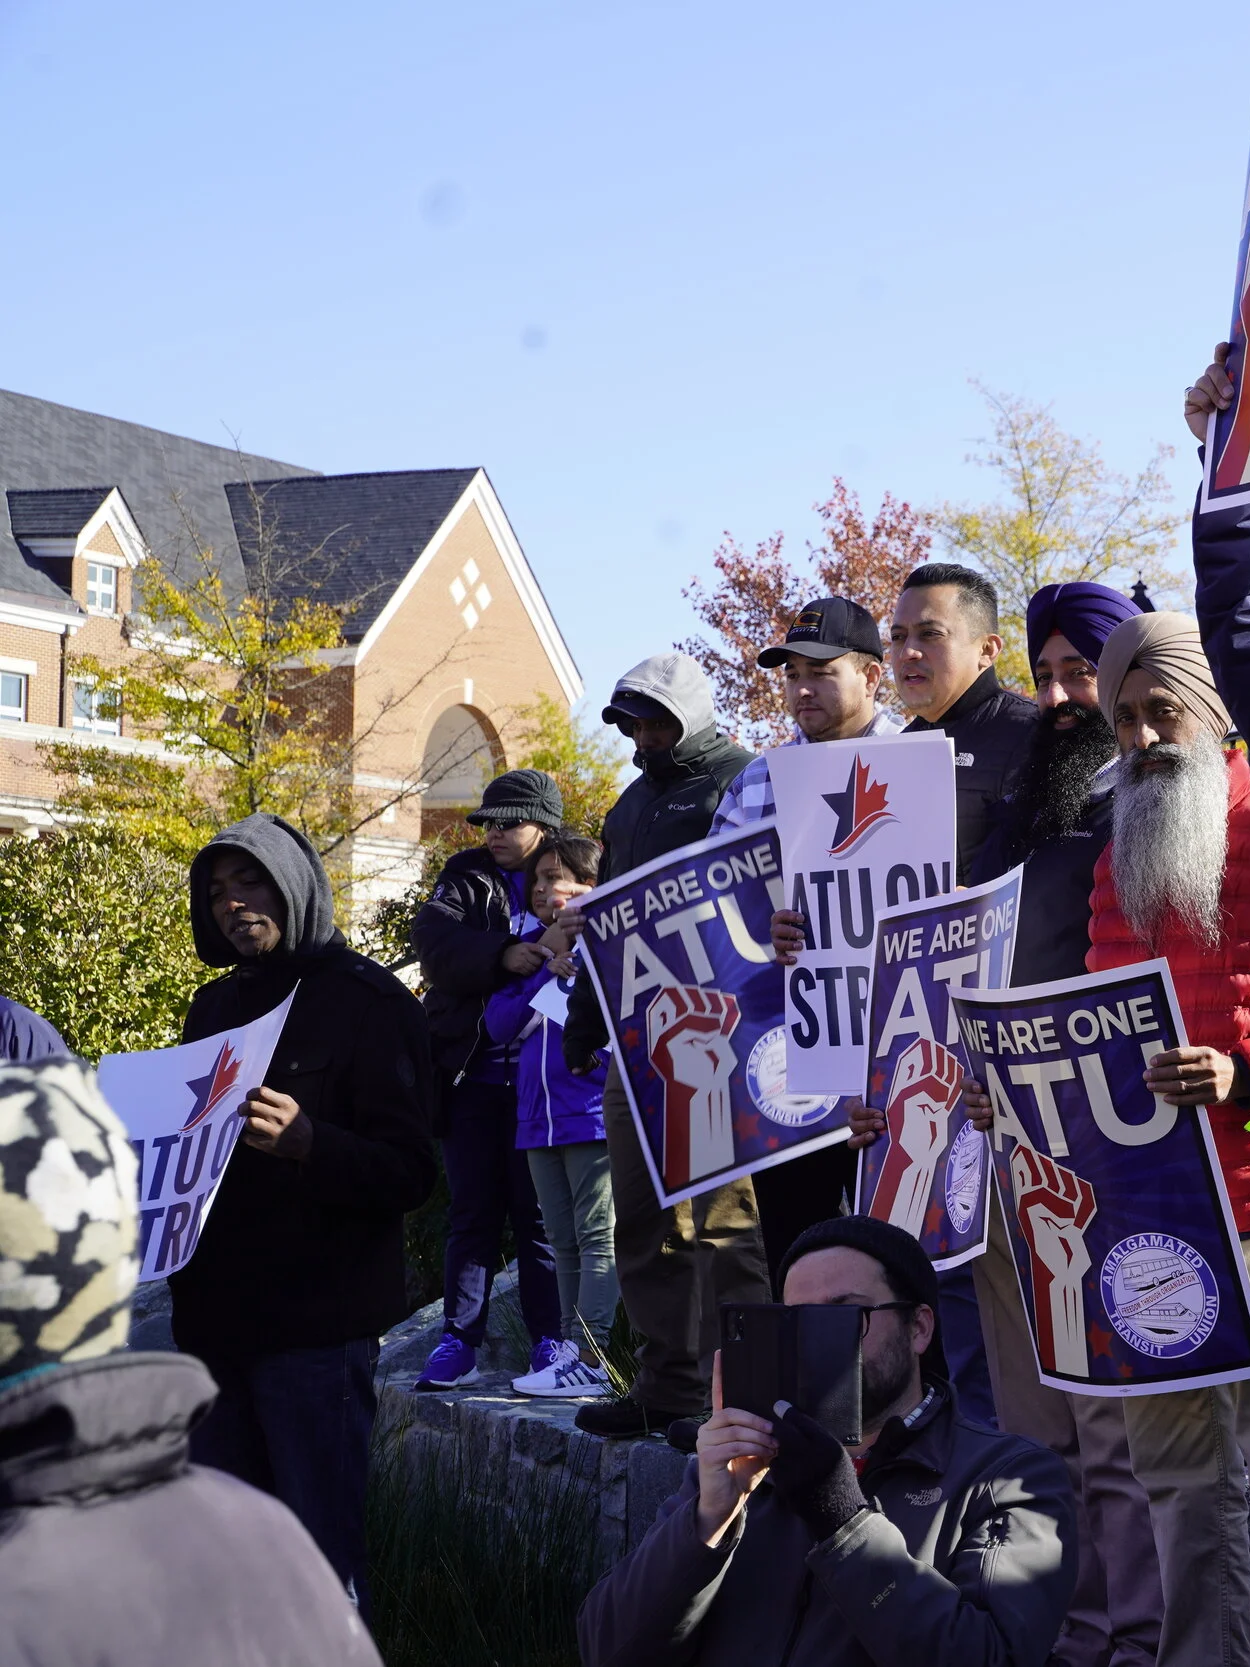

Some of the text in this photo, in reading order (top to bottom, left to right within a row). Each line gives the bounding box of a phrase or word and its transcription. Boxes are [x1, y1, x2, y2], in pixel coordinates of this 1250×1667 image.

[588, 842, 778, 942] WE ARE ONE
[791, 868, 875, 951] ATU
[620, 875, 785, 1021] ATU
[883, 897, 1014, 964] WE ARE ONE
[960, 995, 1159, 1055] WE ARE ONE
[985, 1039, 1179, 1158] ATU
[1102, 1235, 1203, 1287] AMALGAMATED
[1110, 1295, 1217, 1356] TRANSIT UNION
[1121, 1274, 1196, 1316] FREEDOM THROUGH ORGANIZATION
